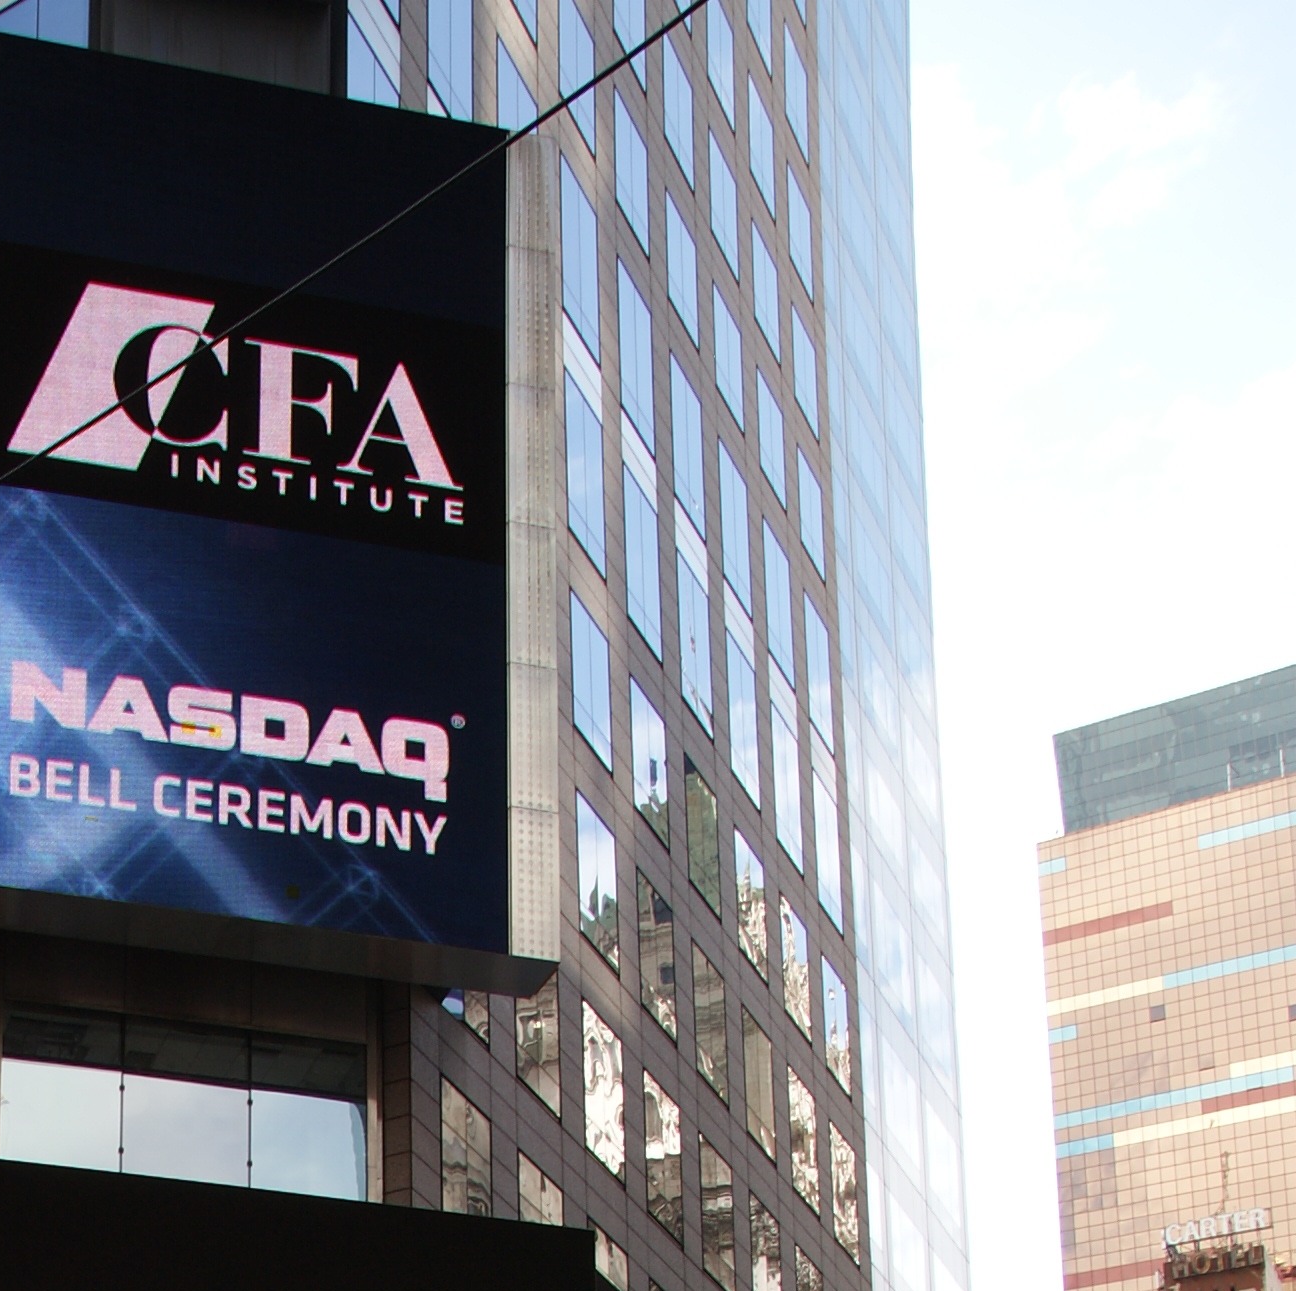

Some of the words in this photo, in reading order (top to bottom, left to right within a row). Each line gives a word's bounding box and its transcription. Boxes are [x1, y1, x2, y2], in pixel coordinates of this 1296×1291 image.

[113, 323, 464, 491] CFA
[170, 452, 465, 525] INSTITUTE
[10, 660, 451, 803] NASDAQ
[8, 753, 137, 812] BELL
[152, 773, 448, 856] CEREMONY
[1165, 1208, 1265, 1246] CARTER
[1172, 1246, 1264, 1280] HOTEL
